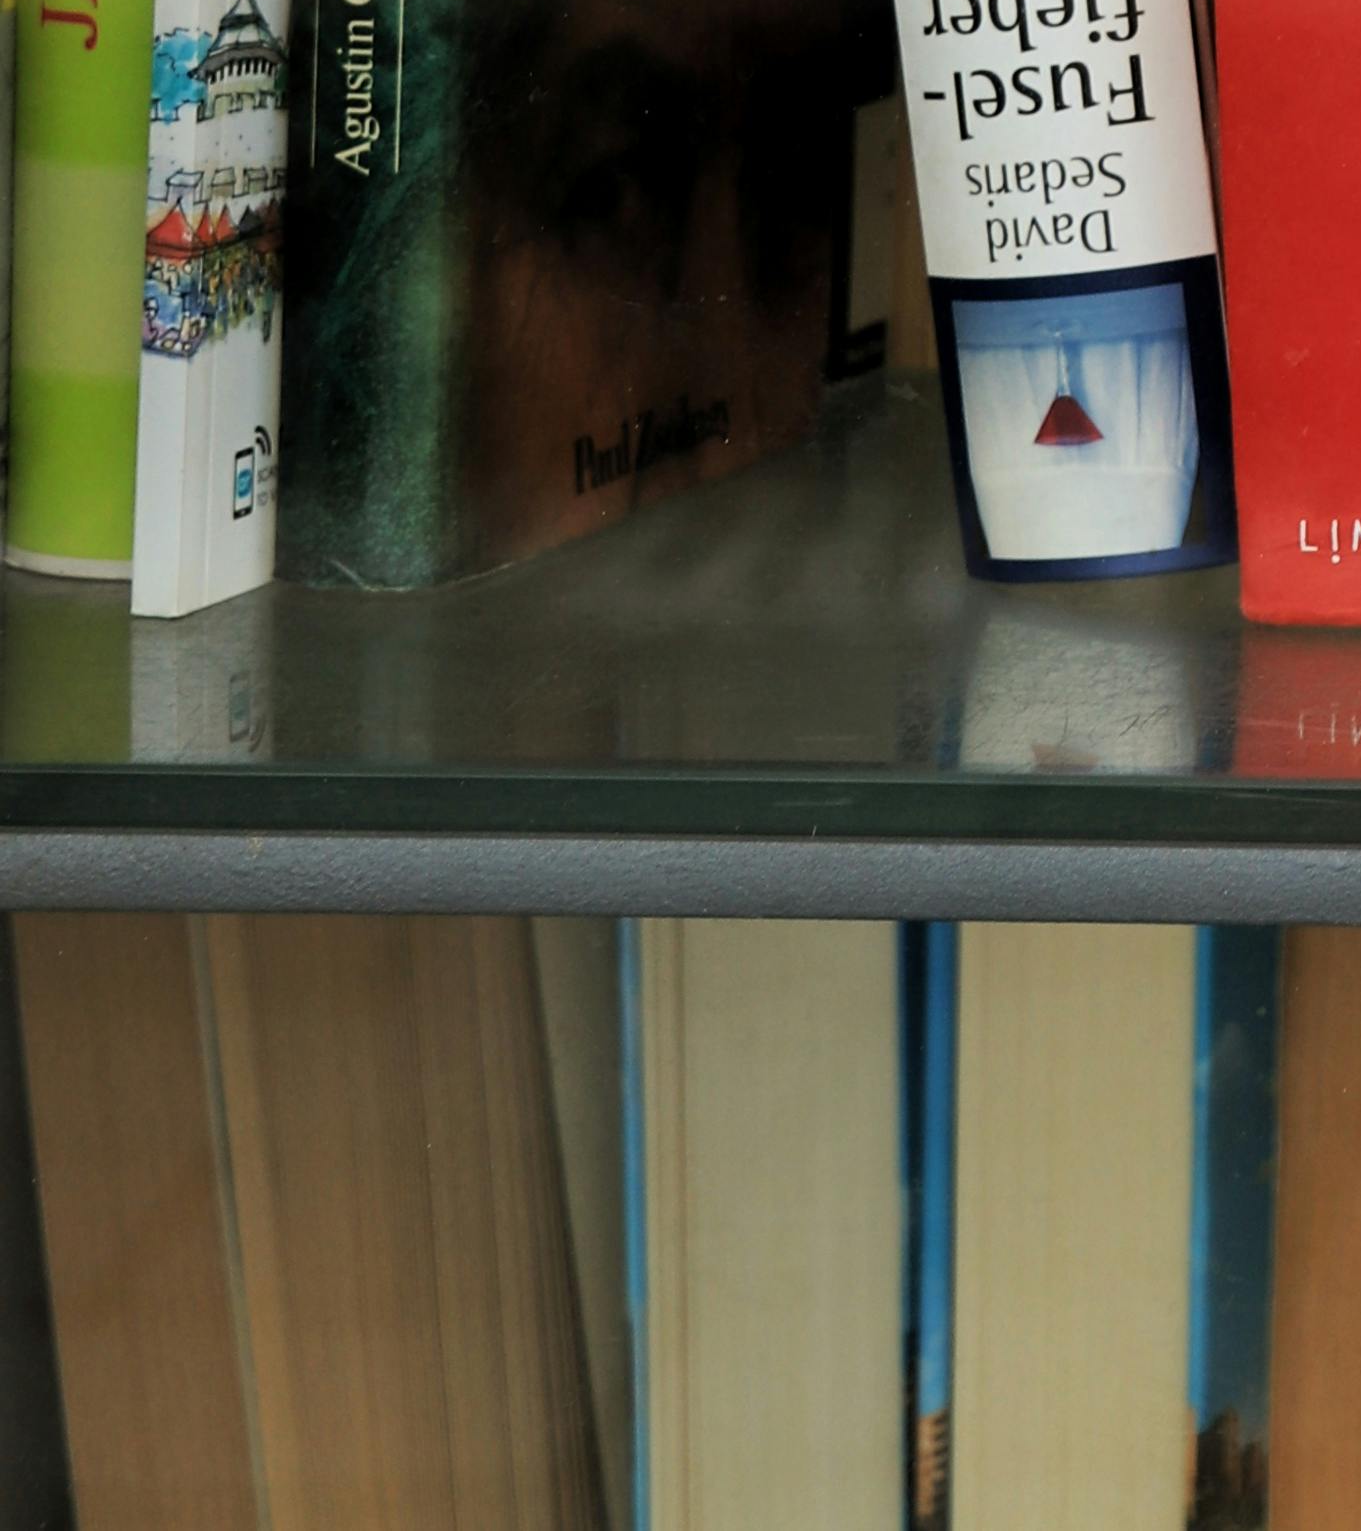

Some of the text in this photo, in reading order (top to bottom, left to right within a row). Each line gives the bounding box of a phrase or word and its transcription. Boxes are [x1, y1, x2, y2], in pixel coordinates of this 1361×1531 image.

[334, 16, 376, 176] Agustin
[923, 54, 1155, 140] Fusel-
[965, 150, 1126, 208] Sedaris
[985, 210, 1117, 263] David
